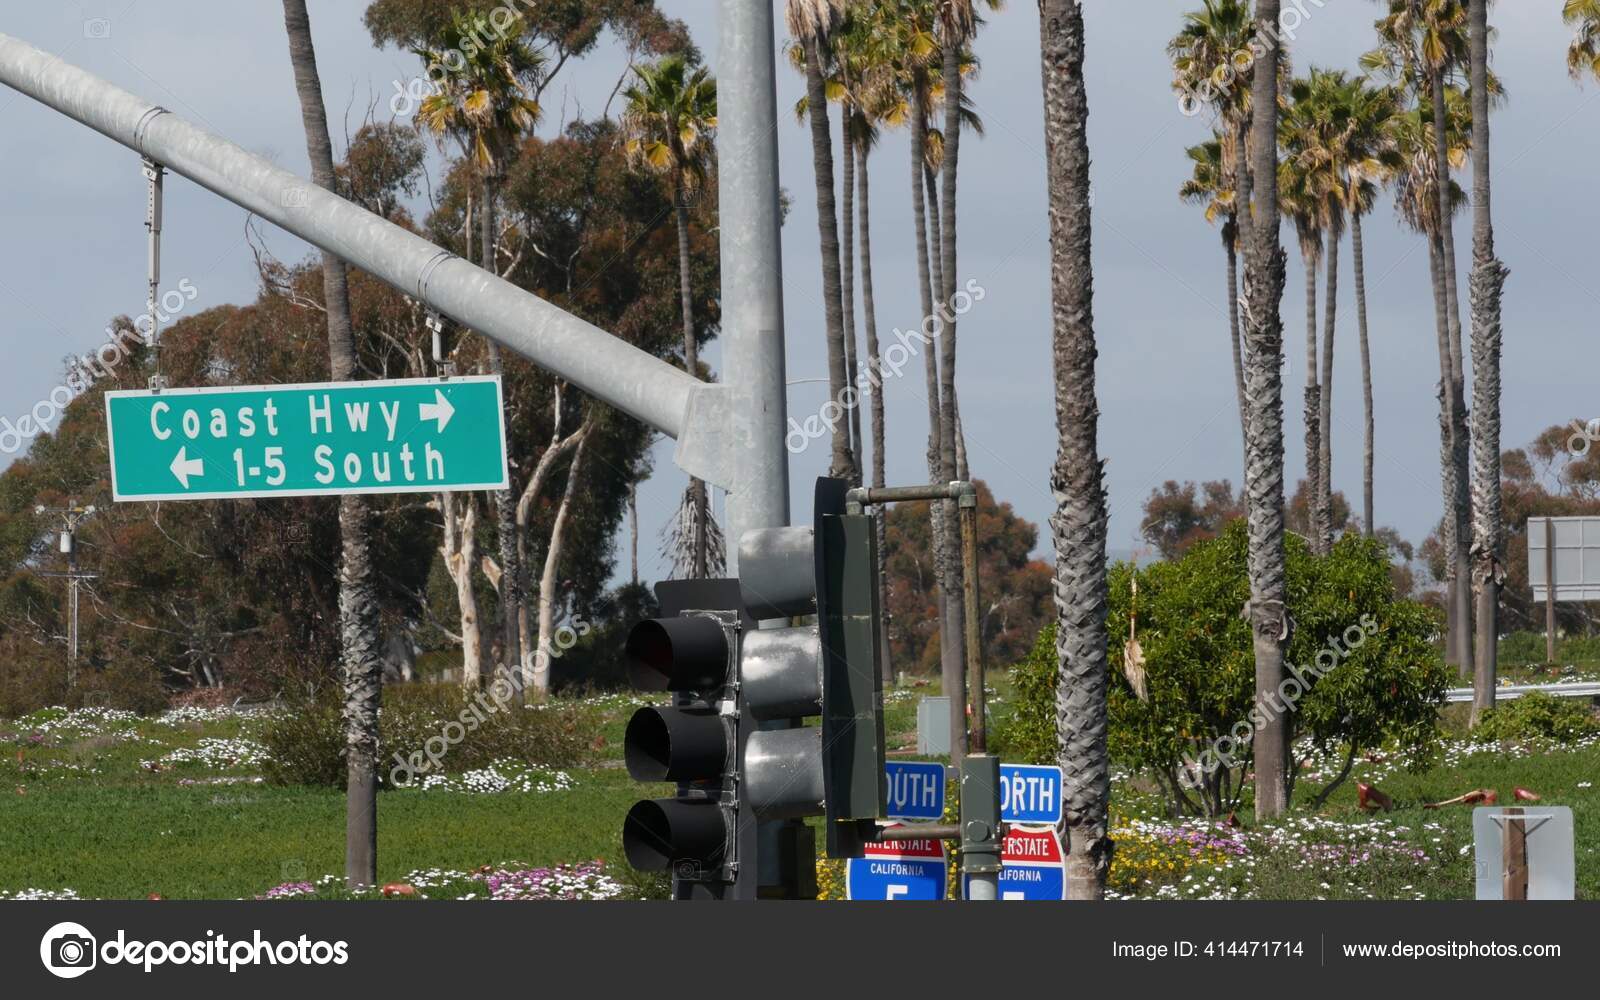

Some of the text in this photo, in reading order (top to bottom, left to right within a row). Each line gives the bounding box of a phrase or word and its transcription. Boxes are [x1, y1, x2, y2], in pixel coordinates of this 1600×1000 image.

[151, 394, 400, 441] Coast Hwy
[314, 442, 444, 484] South
[885, 772, 936, 807] UTH
[1000, 775, 1053, 812] ORTH
[1001, 837, 1049, 856] ERSTATE
[870, 863, 924, 877] CALIFORNIA
[998, 869, 1042, 882] LIFORNIA
